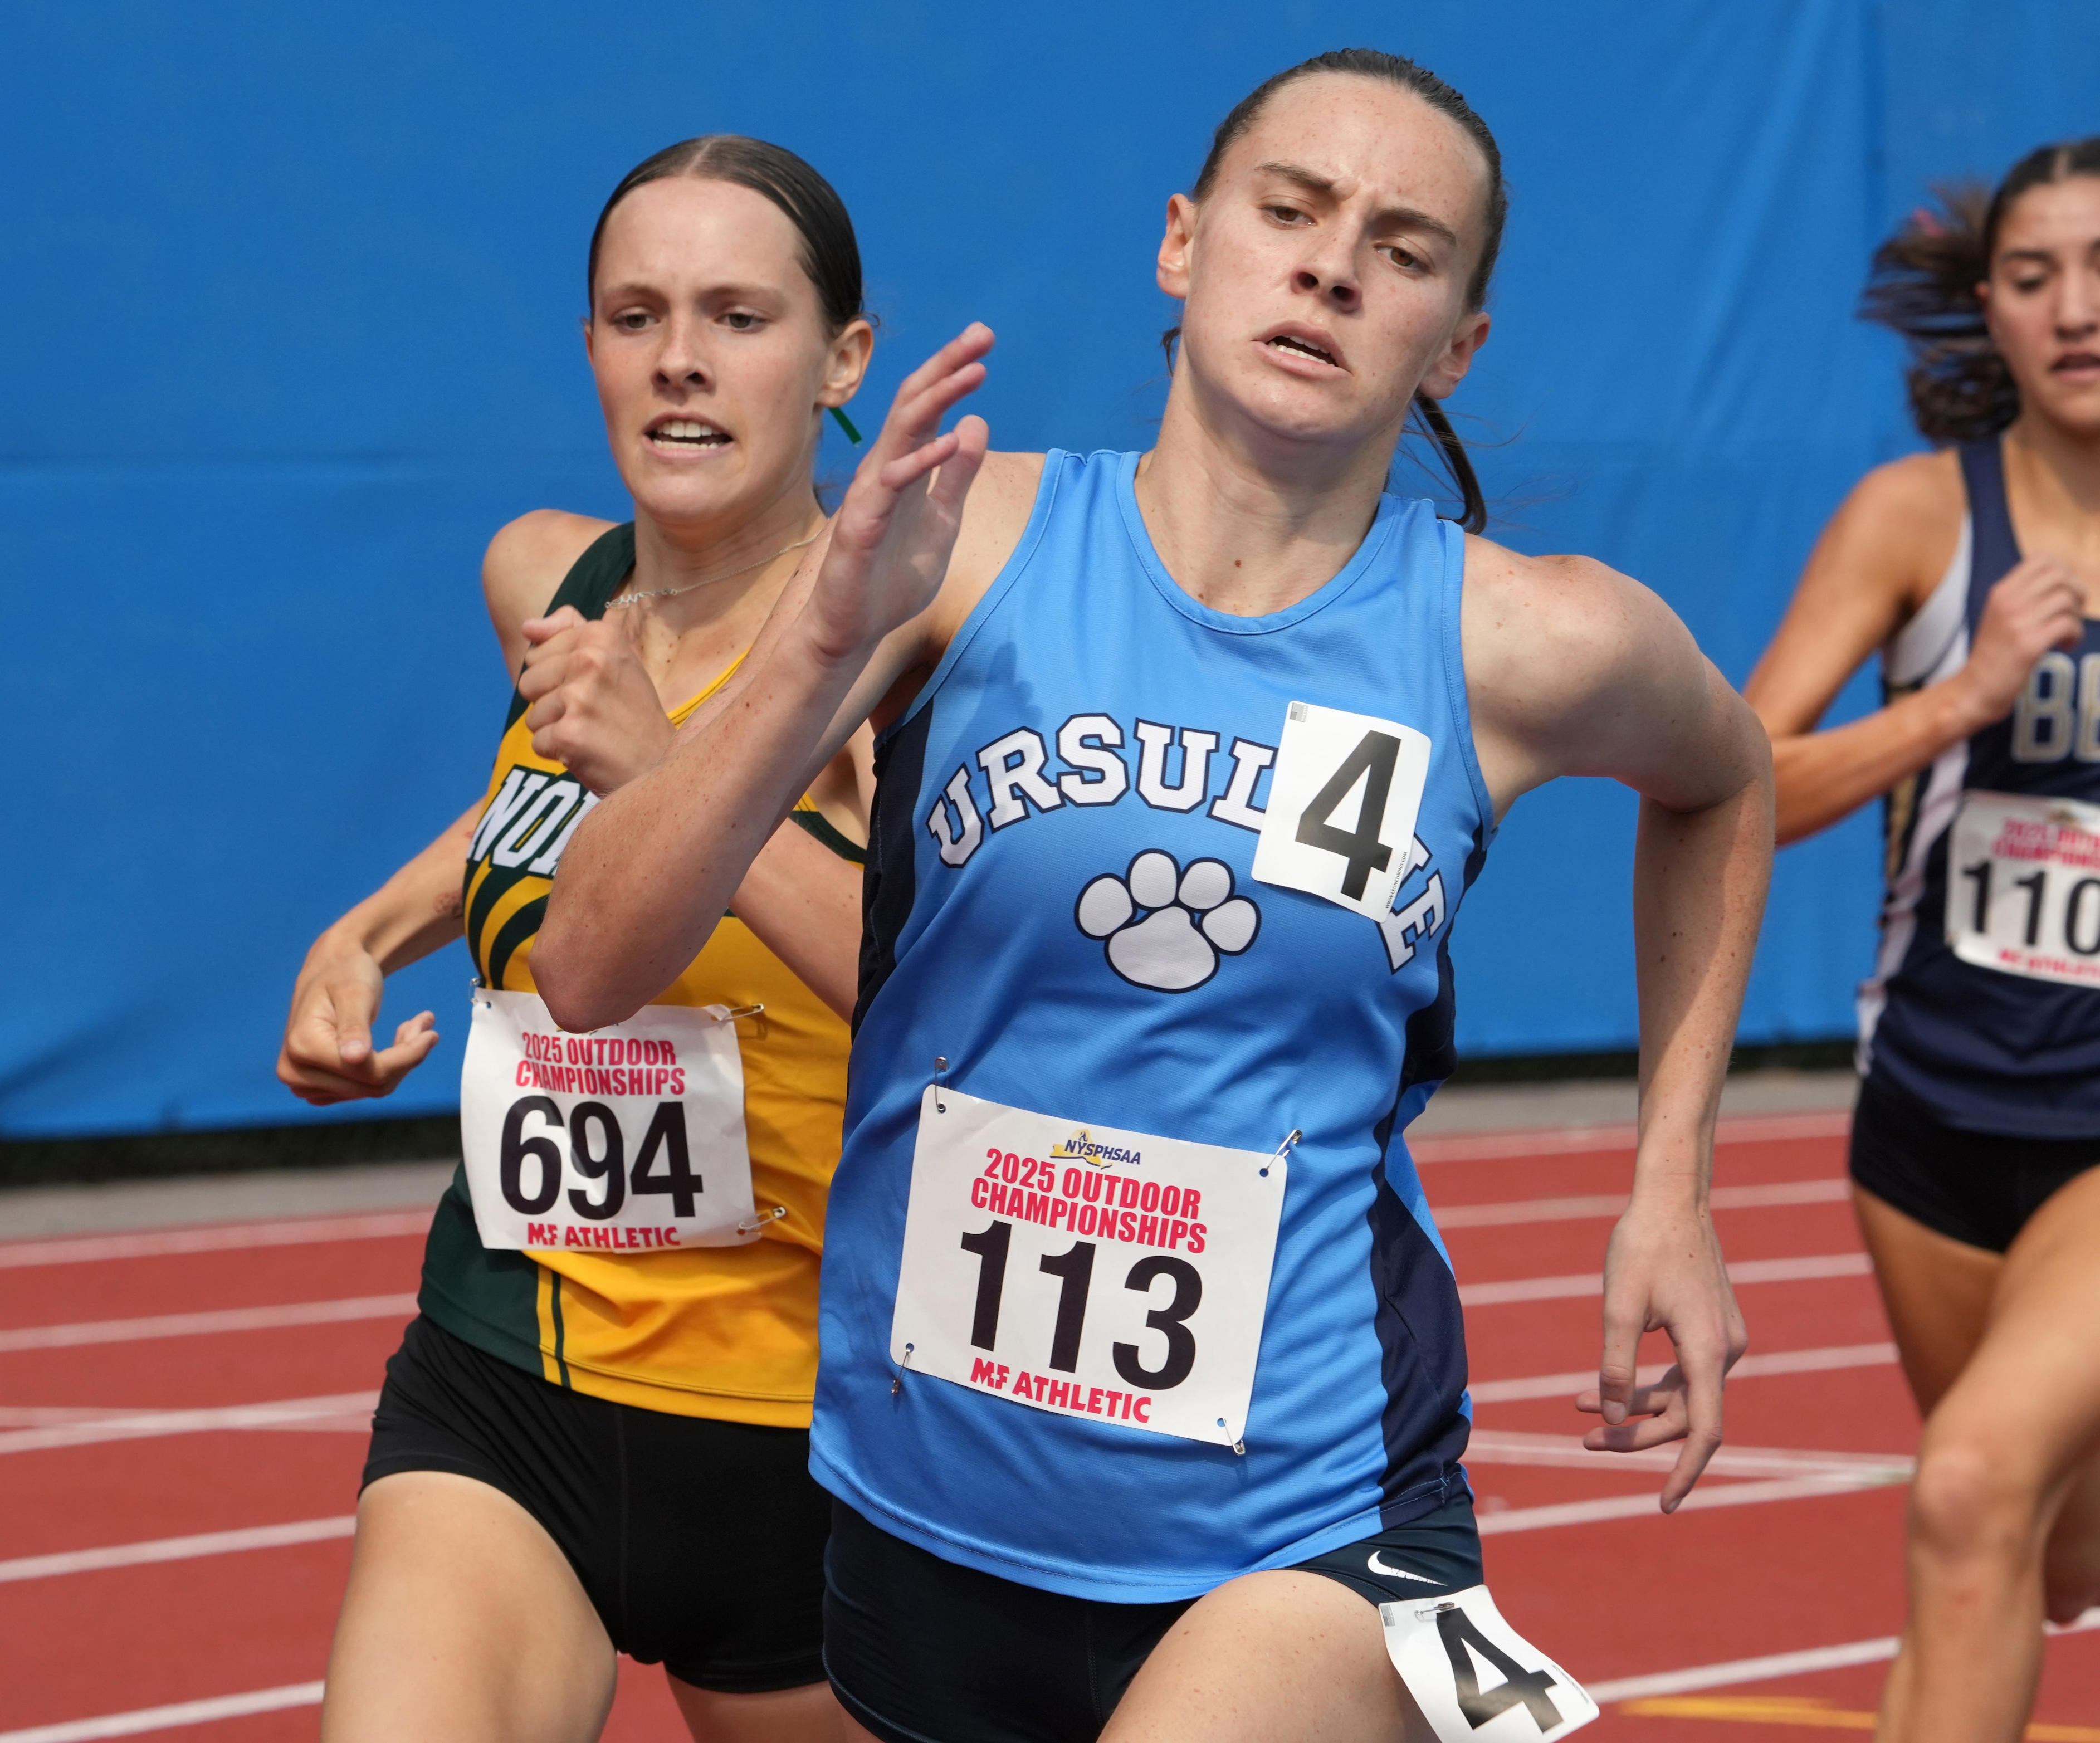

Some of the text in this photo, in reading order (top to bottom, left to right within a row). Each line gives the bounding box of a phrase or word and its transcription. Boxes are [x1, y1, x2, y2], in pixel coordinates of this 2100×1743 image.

[926, 712, 1446, 975] URSULE
[1295, 730, 1401, 902] 4
[515, 1060, 685, 1096] CHAMPIONSHIPS
[522, 1032, 677, 1066] 2025 OUTDOOR
[500, 1095, 704, 1220] 694
[984, 1148, 1202, 1220] 2025 OUTDOOR
[1064, 1139, 1141, 1165] NYSPHSAA
[528, 1222, 682, 1249] MF ATHLETIC
[971, 1177, 1208, 1254] CHAMPIONSHIPS
[960, 1220, 1202, 1391] 113
[970, 1357, 1152, 1423] MF ATHLETIC
[1436, 1607, 1564, 1734] 4
